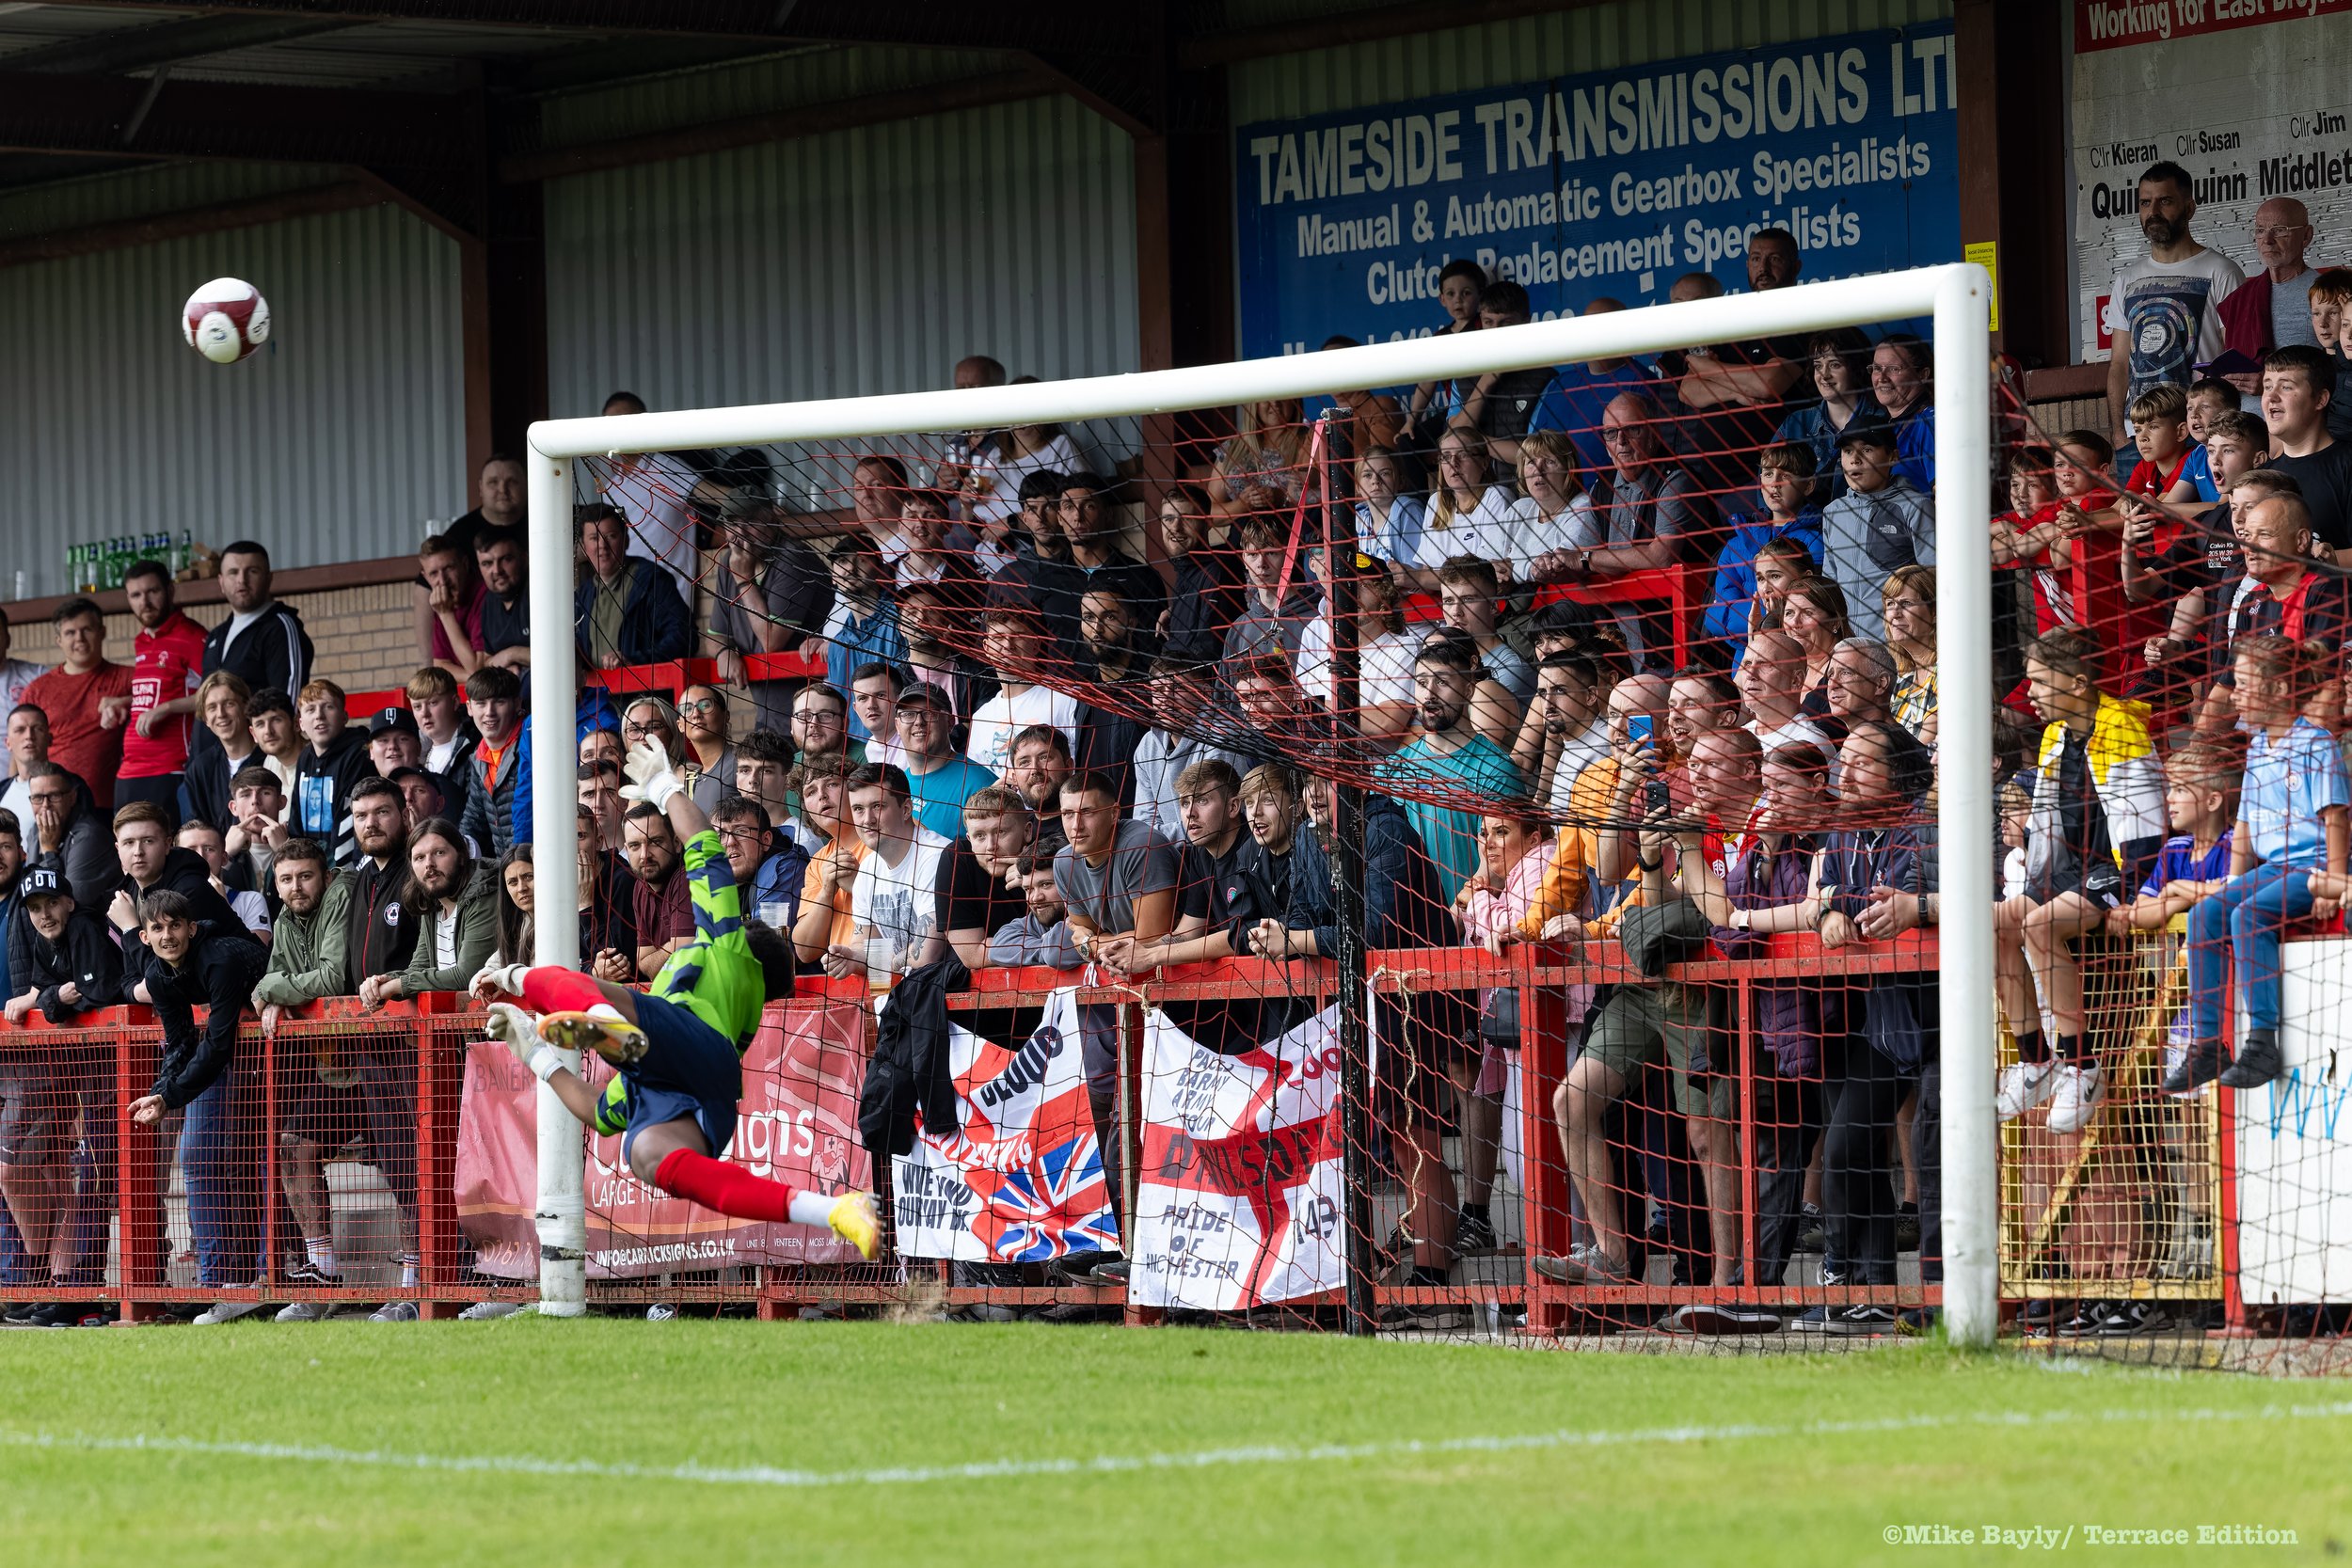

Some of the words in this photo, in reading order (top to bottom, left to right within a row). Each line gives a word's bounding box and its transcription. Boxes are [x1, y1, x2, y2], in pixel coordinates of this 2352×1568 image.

[2089, 0, 2170, 40] Working
[1251, 110, 1463, 206] TAMESIDE
[1475, 47, 1869, 175] TRANSMISSIONS
[2290, 117, 2311, 139] Cllr
[2312, 111, 2346, 135] Jim
[2112, 143, 2158, 166] Kieran
[2176, 135, 2197, 157] Cllr
[2199, 131, 2241, 154] Susan
[1297, 203, 1400, 258] Manual
[1411, 199, 1435, 244] &
[1444, 178, 1601, 239] Automatic
[1610, 164, 1741, 216] Gearbox
[1753, 135, 1931, 205] Specialists
[21, 874, 56, 897] ICON
[1161, 1205, 1230, 1233] PRIDE
[1170, 1235, 1204, 1254] OF
[1146, 1253, 1239, 1279] ANCHESTER
